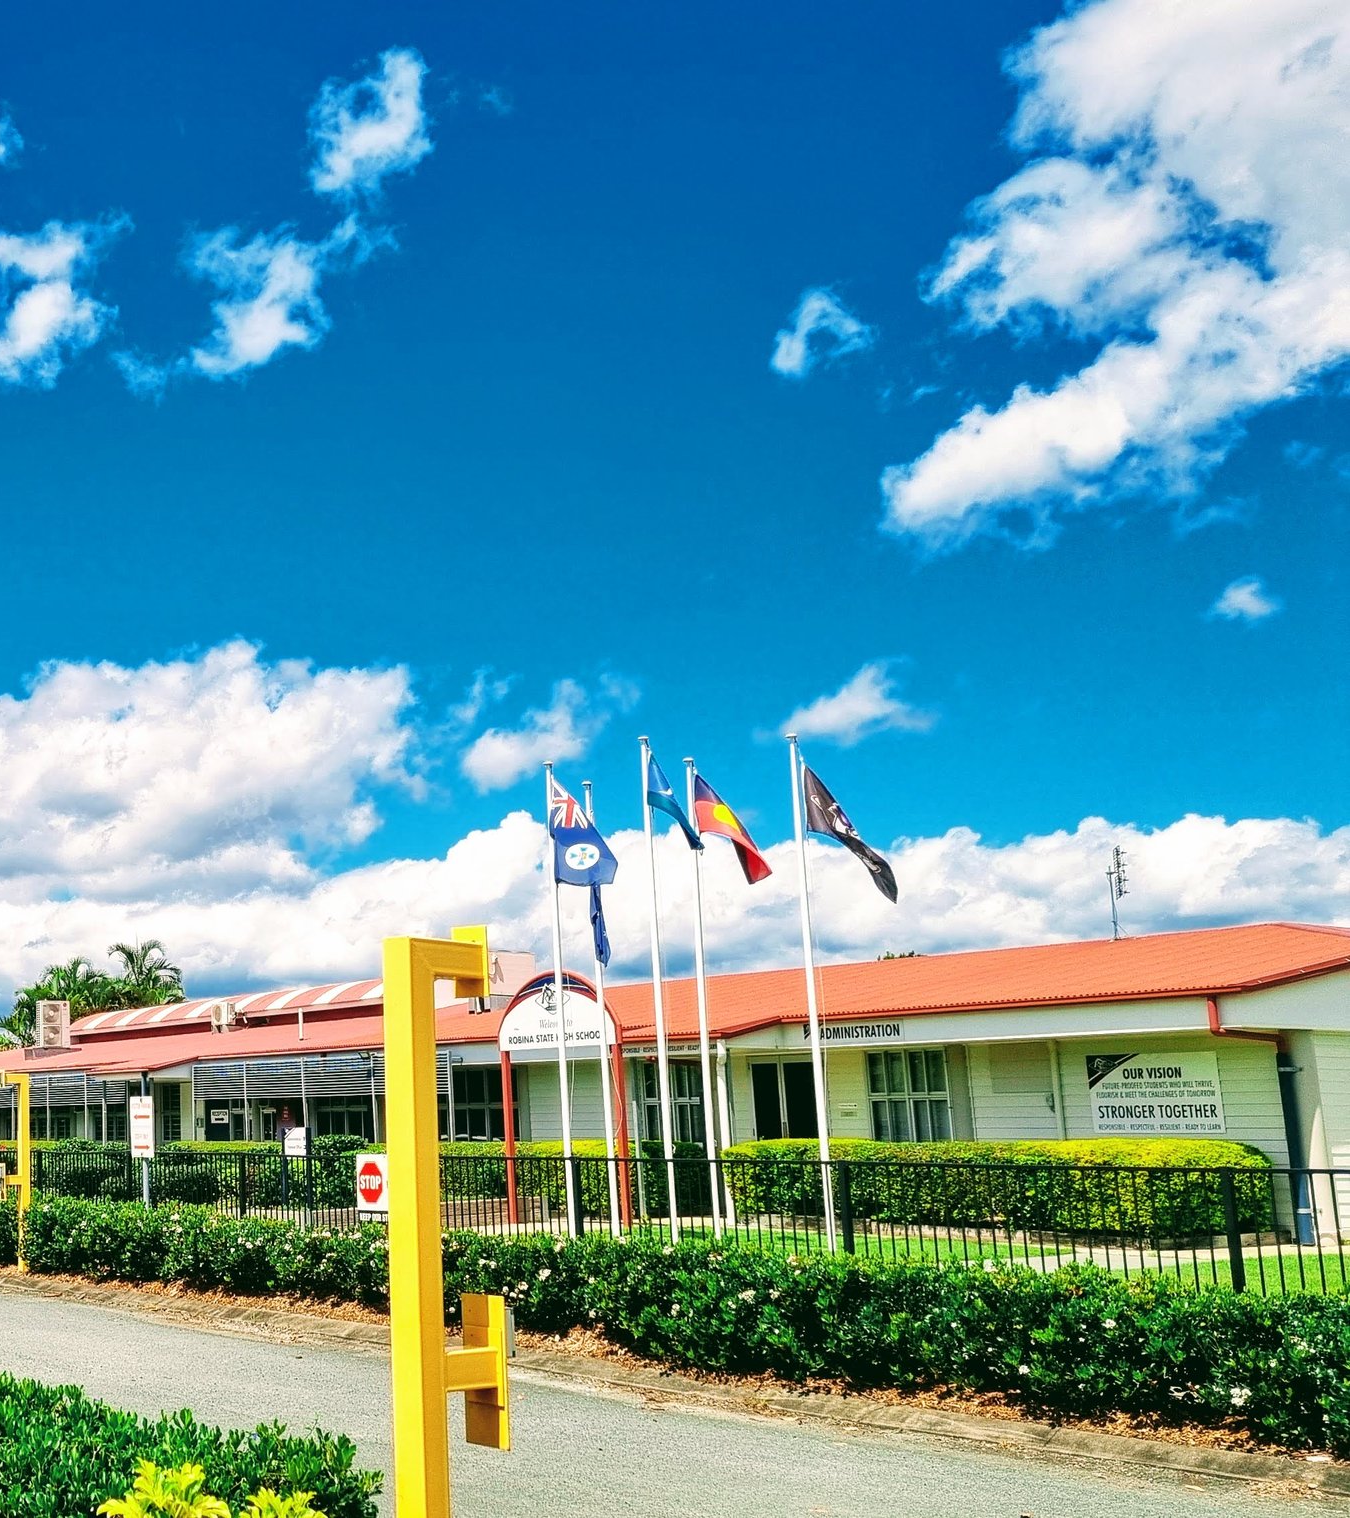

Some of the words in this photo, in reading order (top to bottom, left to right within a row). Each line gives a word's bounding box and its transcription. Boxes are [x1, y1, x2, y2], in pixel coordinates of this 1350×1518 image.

[509, 1035, 534, 1044] ROBINA
[537, 1033, 554, 1043] STATE
[576, 1030, 601, 1041] SCHOO
[820, 1023, 900, 1040] ADMINISTRATION
[1122, 1068, 1144, 1079] OUR
[1146, 1067, 1182, 1079] VISION
[1098, 1105, 1156, 1119] STRONGER
[1157, 1104, 1218, 1118] TOGETHER
[360, 1175, 381, 1190] STOP
